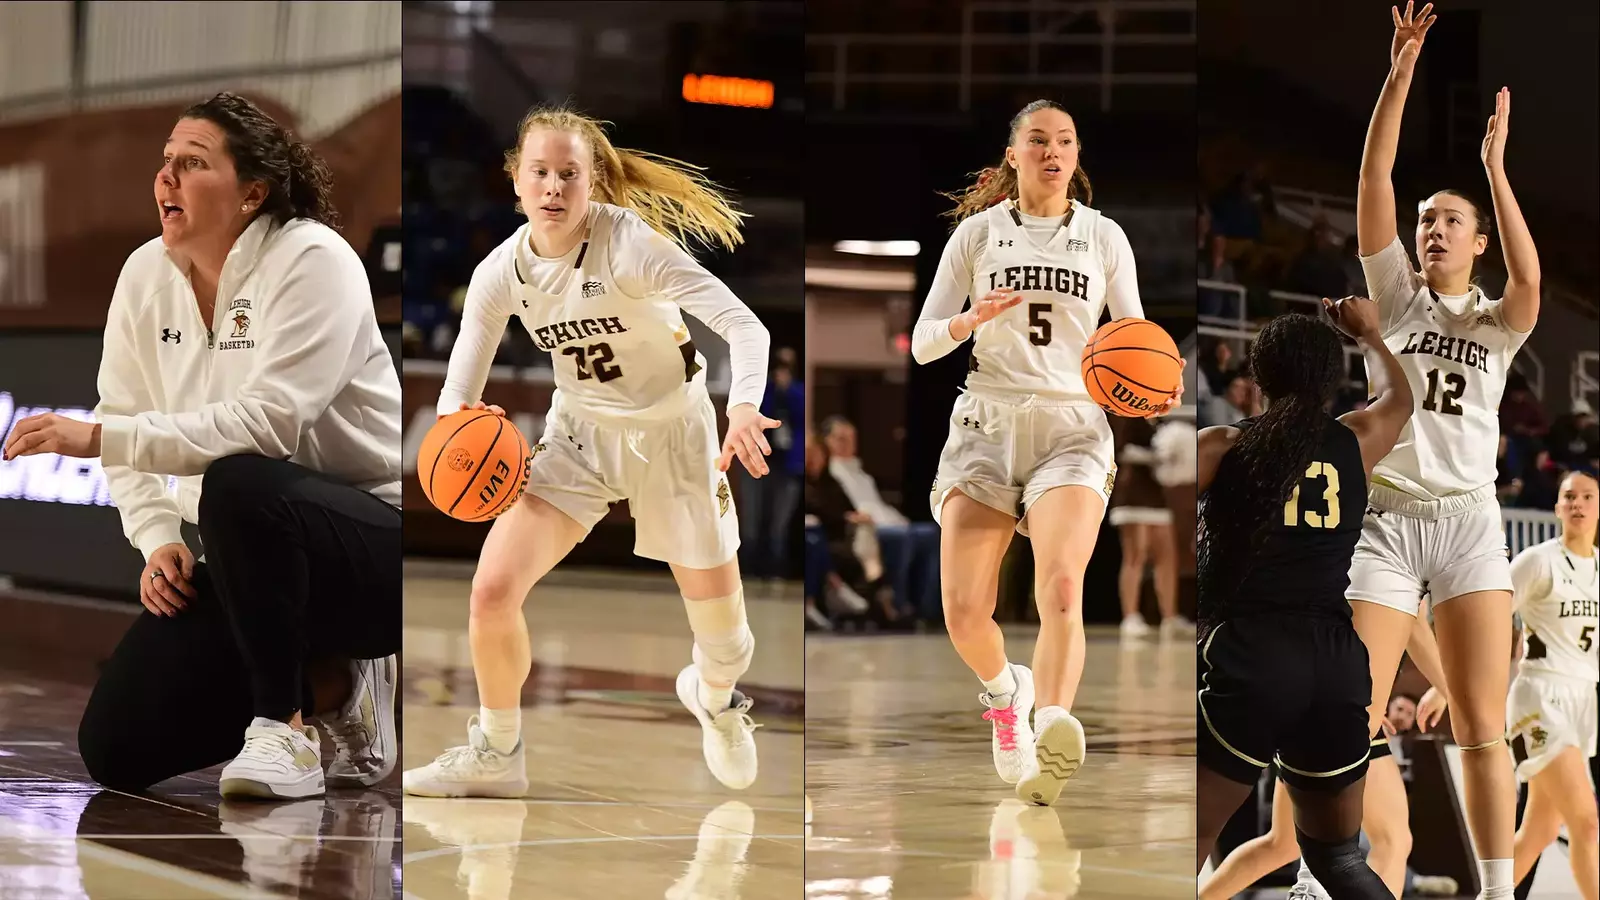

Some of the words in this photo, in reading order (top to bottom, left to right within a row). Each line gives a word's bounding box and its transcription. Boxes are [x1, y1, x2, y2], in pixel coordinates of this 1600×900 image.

[989, 265, 1090, 302] LEHIGH
[534, 316, 628, 350] EHIGH
[1028, 302, 1053, 347] 5
[1400, 330, 1490, 374] LEHIGH
[1421, 367, 1467, 416] 12
[1283, 460, 1341, 529] 13
[1578, 625, 1596, 653] 5
